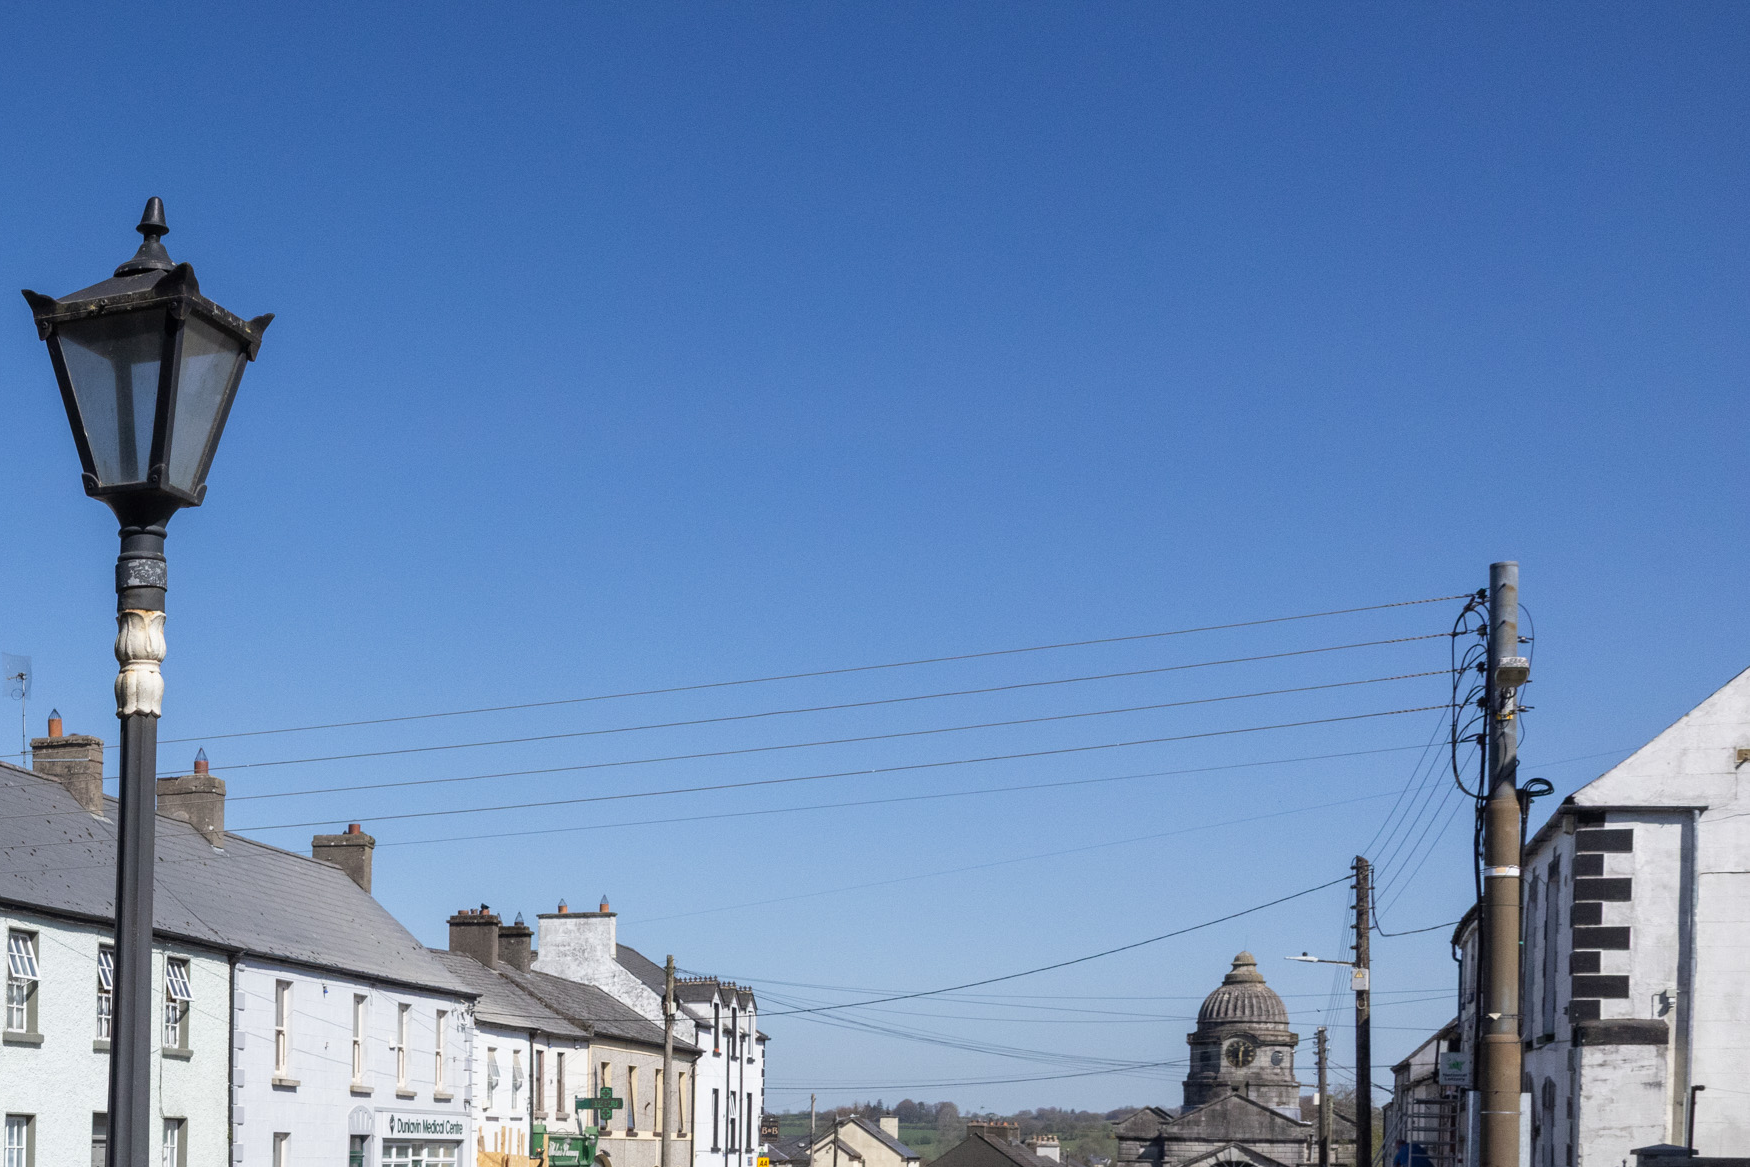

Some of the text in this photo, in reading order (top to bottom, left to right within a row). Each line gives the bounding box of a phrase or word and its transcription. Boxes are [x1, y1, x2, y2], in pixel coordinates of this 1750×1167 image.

[398, 1118, 462, 1134] Dunlavin Medical Centre
